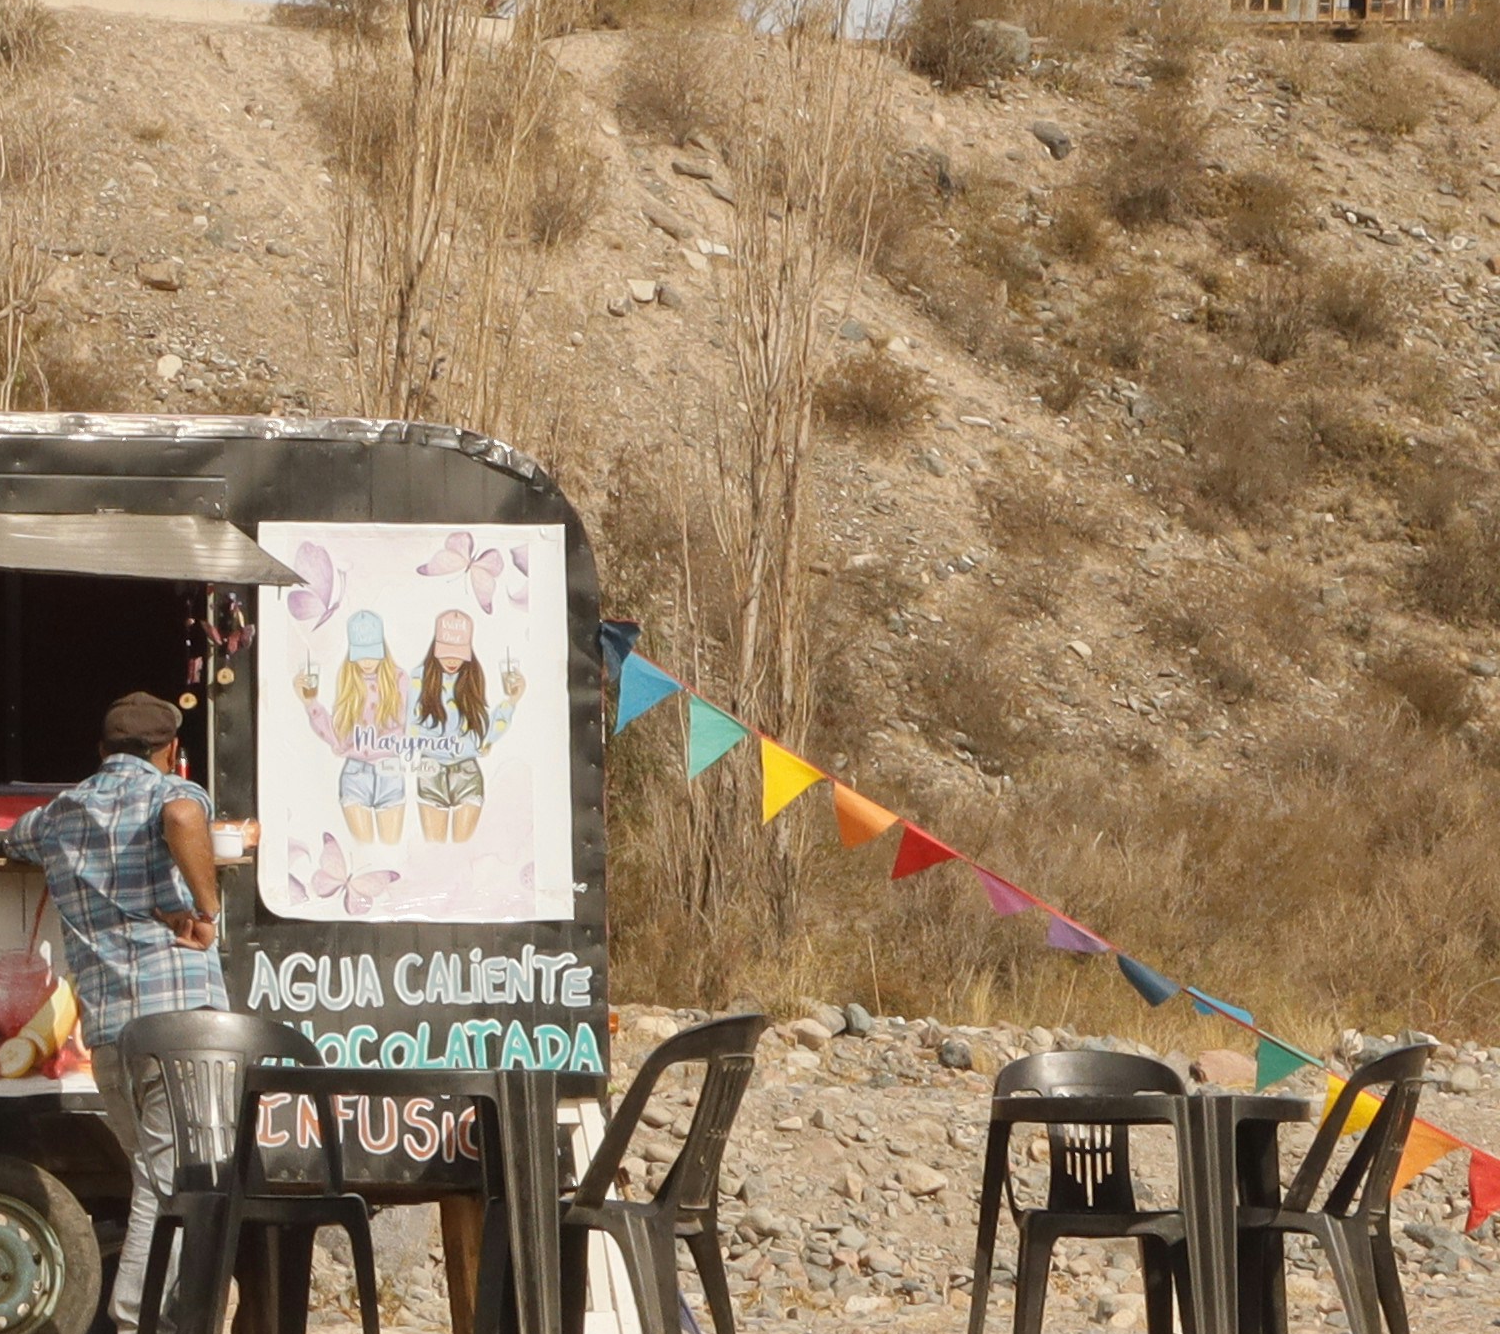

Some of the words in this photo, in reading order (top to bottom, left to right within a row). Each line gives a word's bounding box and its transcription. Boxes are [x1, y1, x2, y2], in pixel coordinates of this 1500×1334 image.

[354, 725, 464, 762] Marymar
[247, 950, 384, 1012] AGUA
[259, 1019, 604, 1070] OCOLATADA
